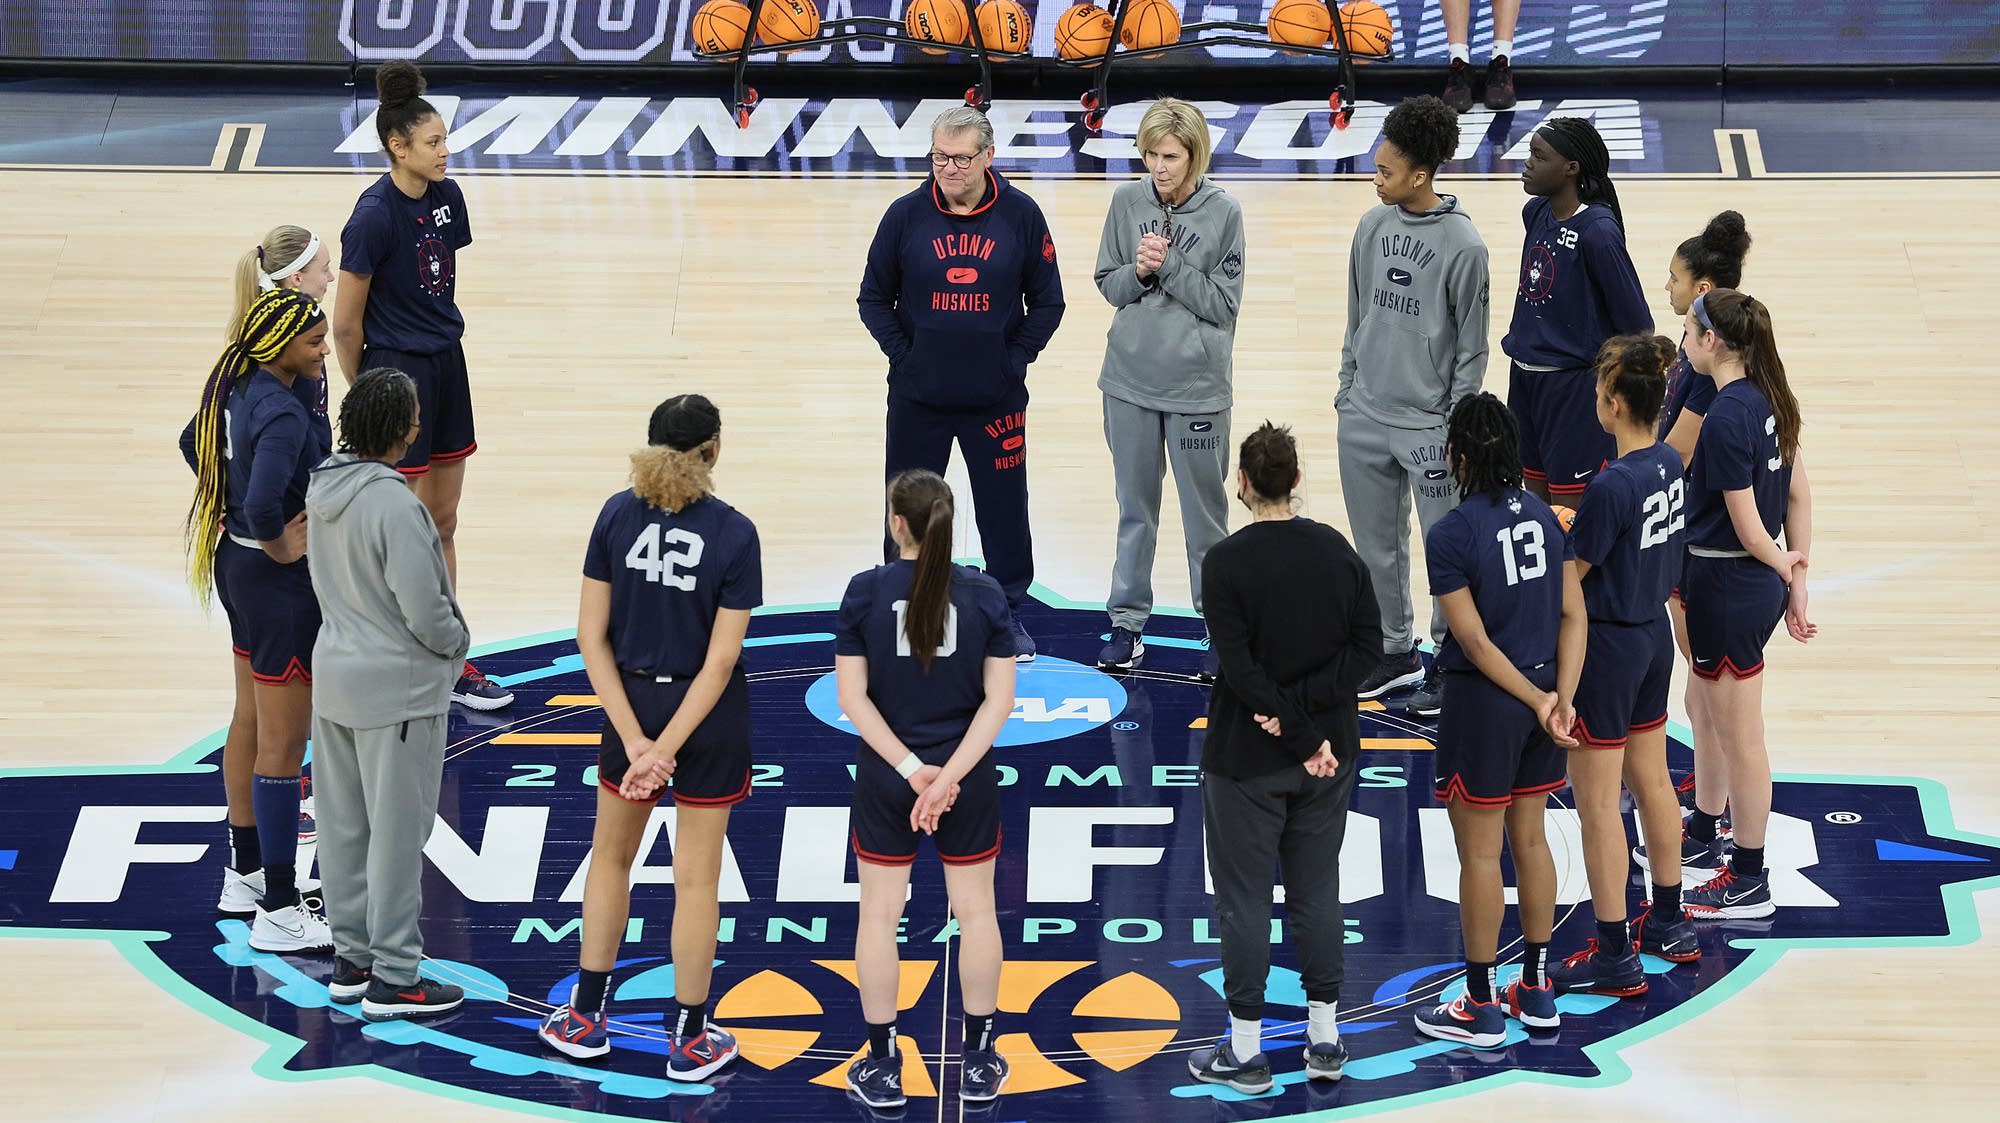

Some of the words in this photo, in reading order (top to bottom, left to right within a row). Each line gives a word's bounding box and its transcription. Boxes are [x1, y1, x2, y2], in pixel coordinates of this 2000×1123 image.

[1006, 12, 1019, 43] NCAA
[432, 205, 451, 228] 20
[931, 233, 997, 262] UCONN
[1381, 233, 1436, 271] UCONN
[1557, 227, 1579, 250] 32
[931, 291, 990, 312] HUSKIES
[1373, 287, 1420, 316] HUSKIES
[1180, 434, 1221, 451] HUSKIES
[1410, 445, 1448, 465] UCON
[1640, 477, 1685, 550] 22
[625, 522, 705, 592] 42
[1496, 520, 1548, 587] 13
[259, 777, 301, 785] ZENSA
